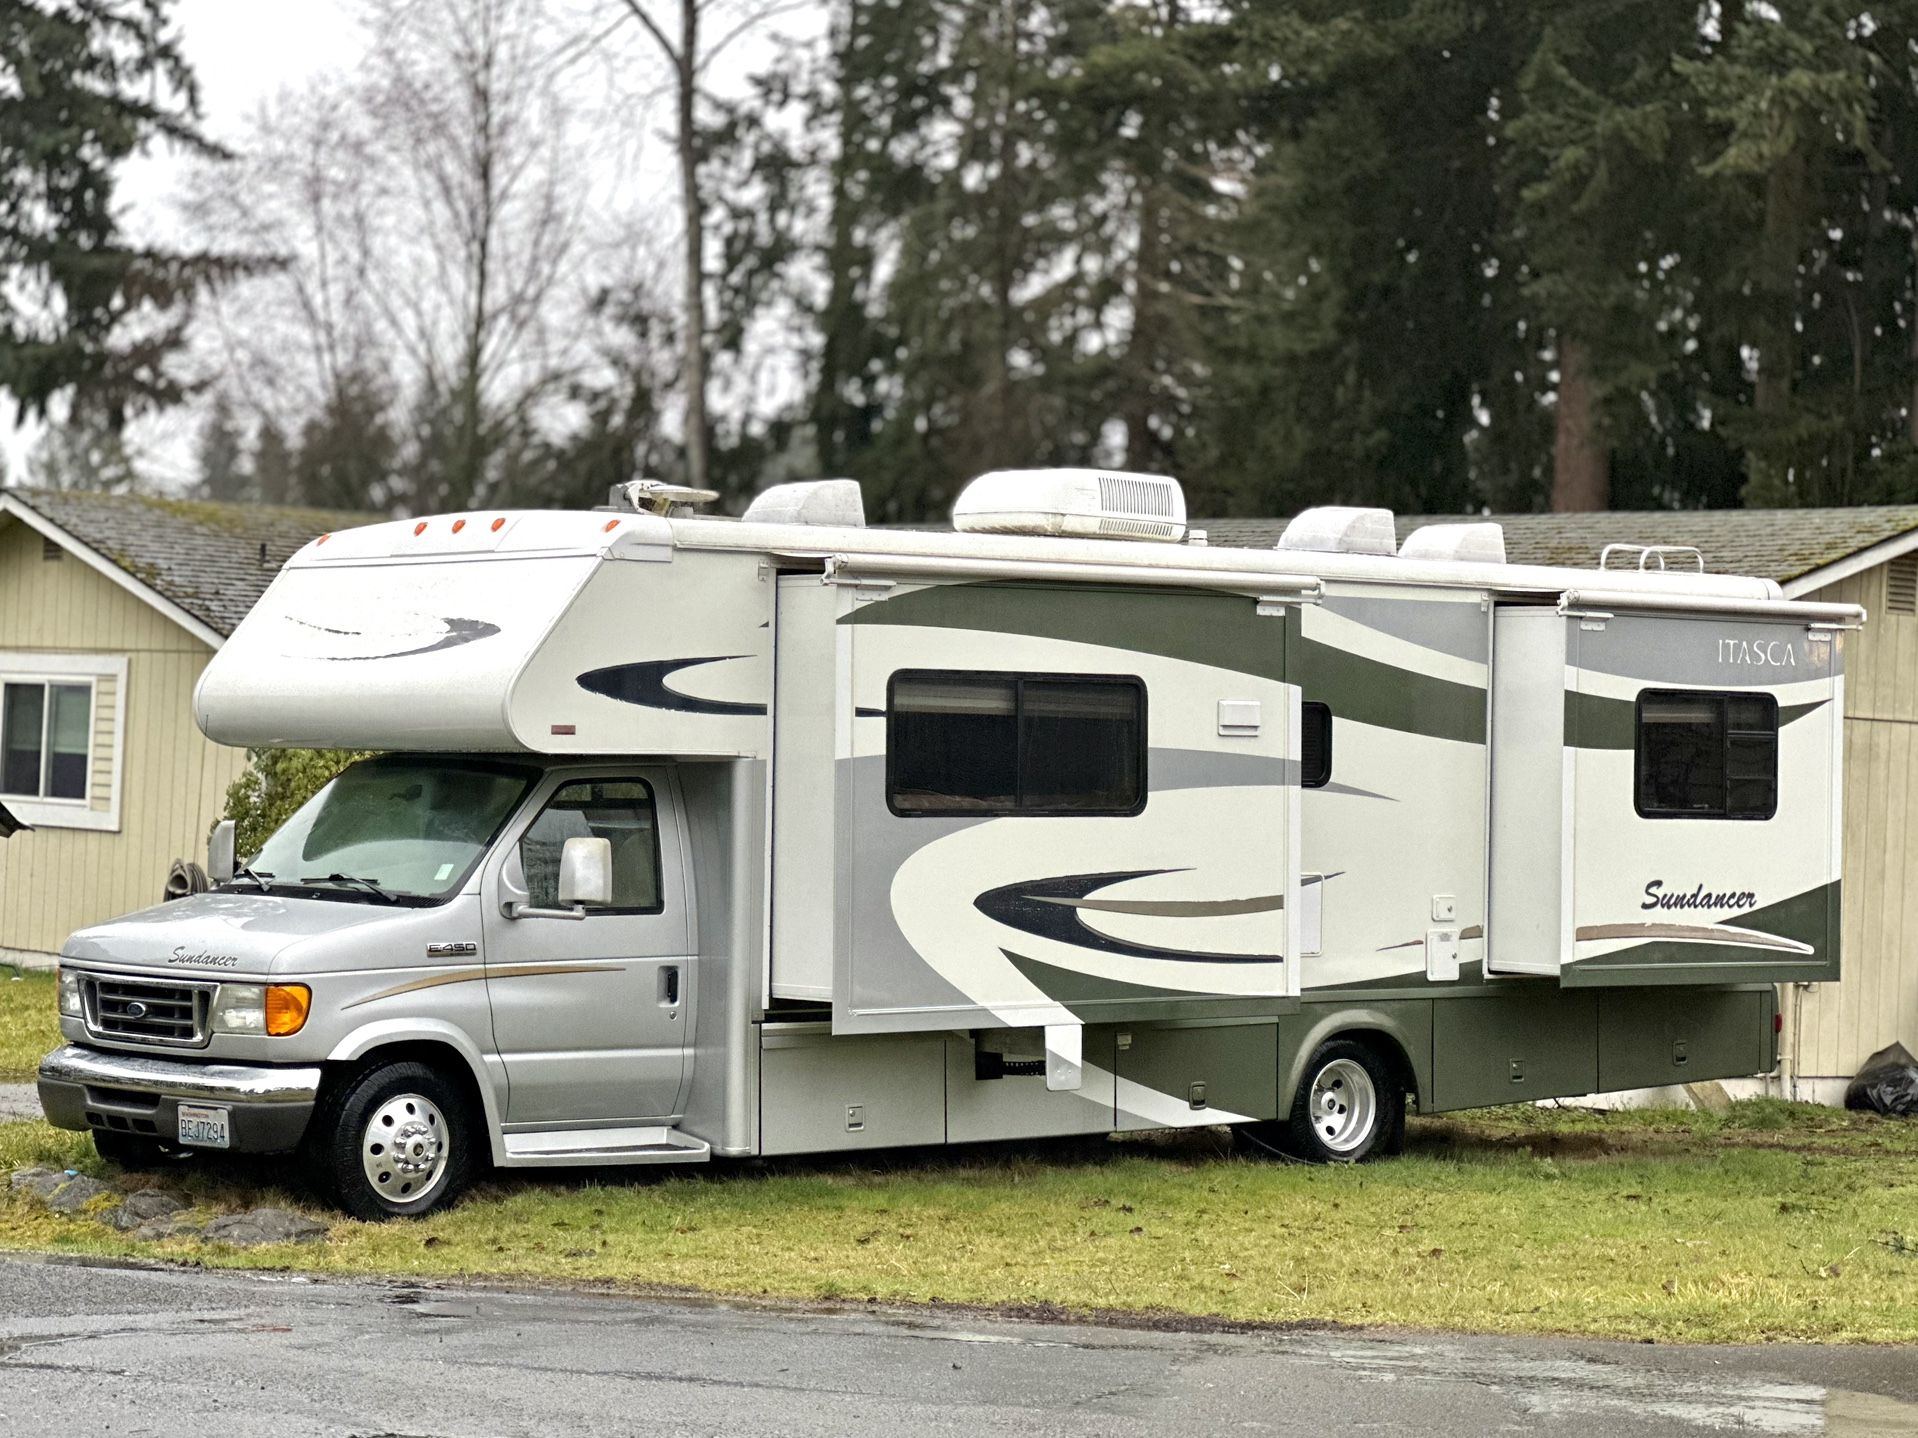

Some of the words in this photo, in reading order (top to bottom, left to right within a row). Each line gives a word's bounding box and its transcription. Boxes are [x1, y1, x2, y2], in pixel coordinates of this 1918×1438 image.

[1718, 639, 1796, 666] ITASCA
[1640, 879, 1758, 910] Sundancer
[167, 945, 239, 967] Sundancer
[180, 1119, 226, 1141] BEJ7294
